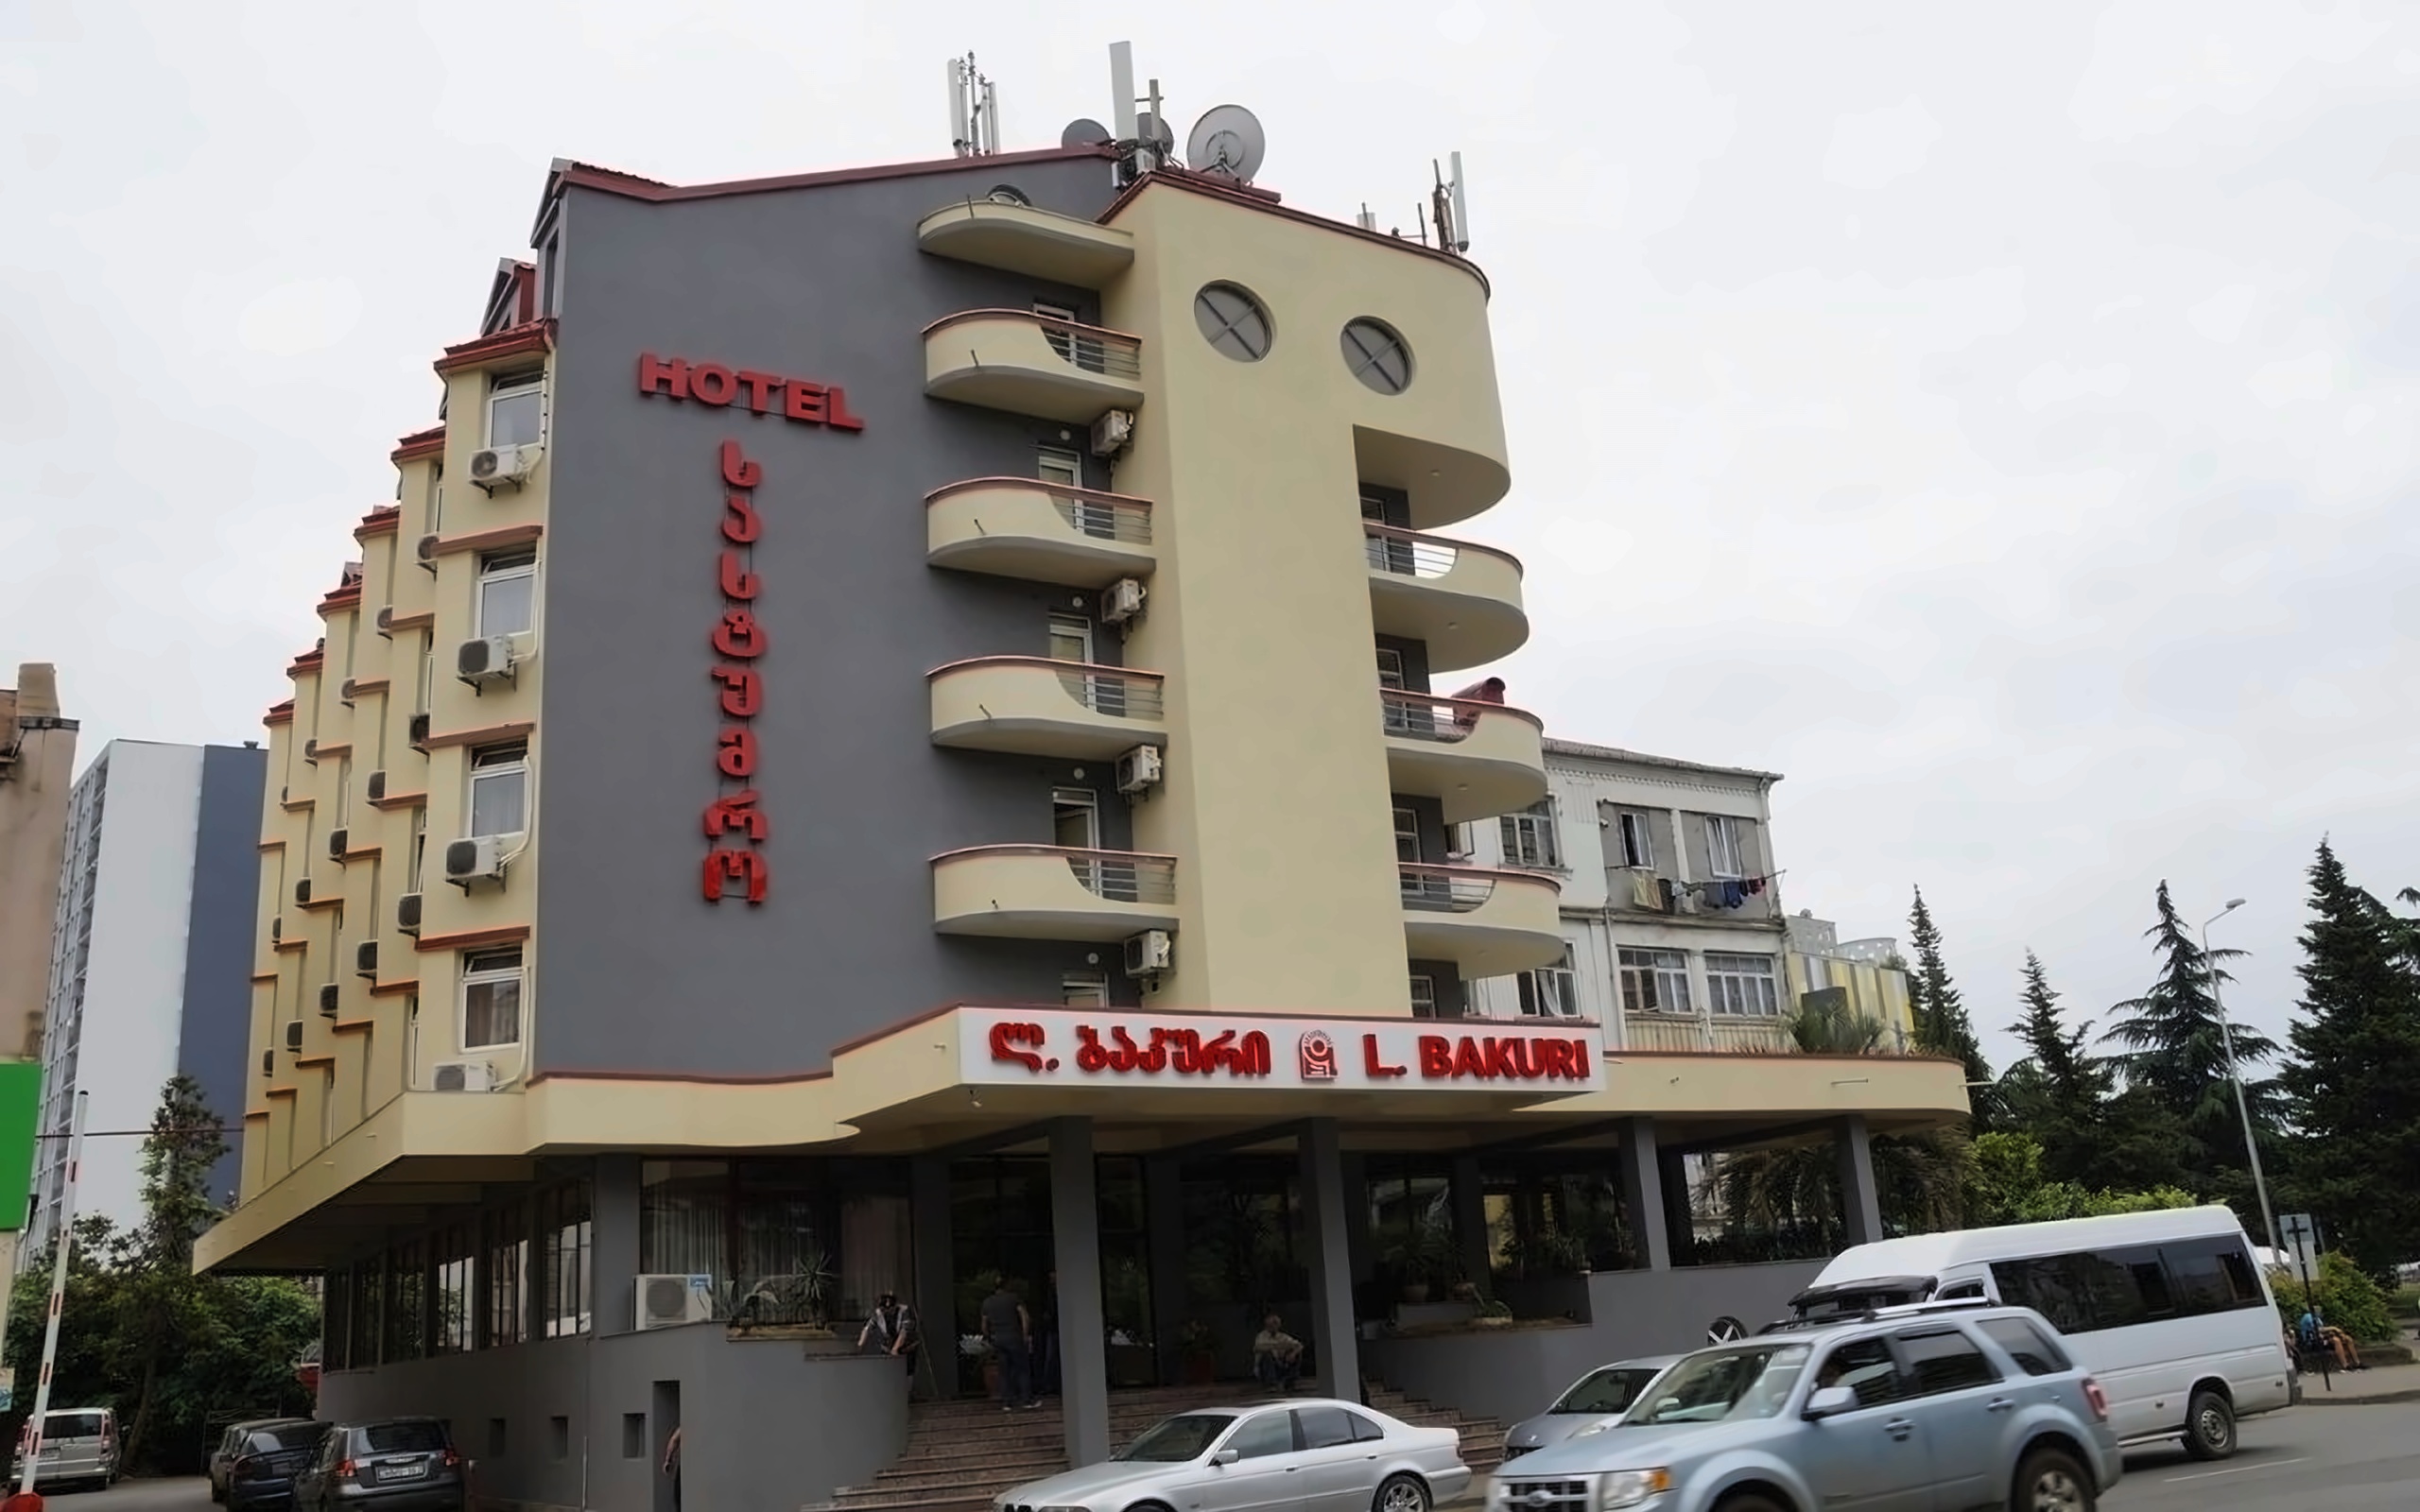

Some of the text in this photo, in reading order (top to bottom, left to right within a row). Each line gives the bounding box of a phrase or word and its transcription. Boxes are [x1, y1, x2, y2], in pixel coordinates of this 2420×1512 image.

[639, 352, 864, 432] HOTEL
[702, 439, 769, 904] სასტუმრო
[990, 1022, 1271, 1076] ლ. ბაკური
[1362, 1034, 1591, 1079] L. BAKURI
